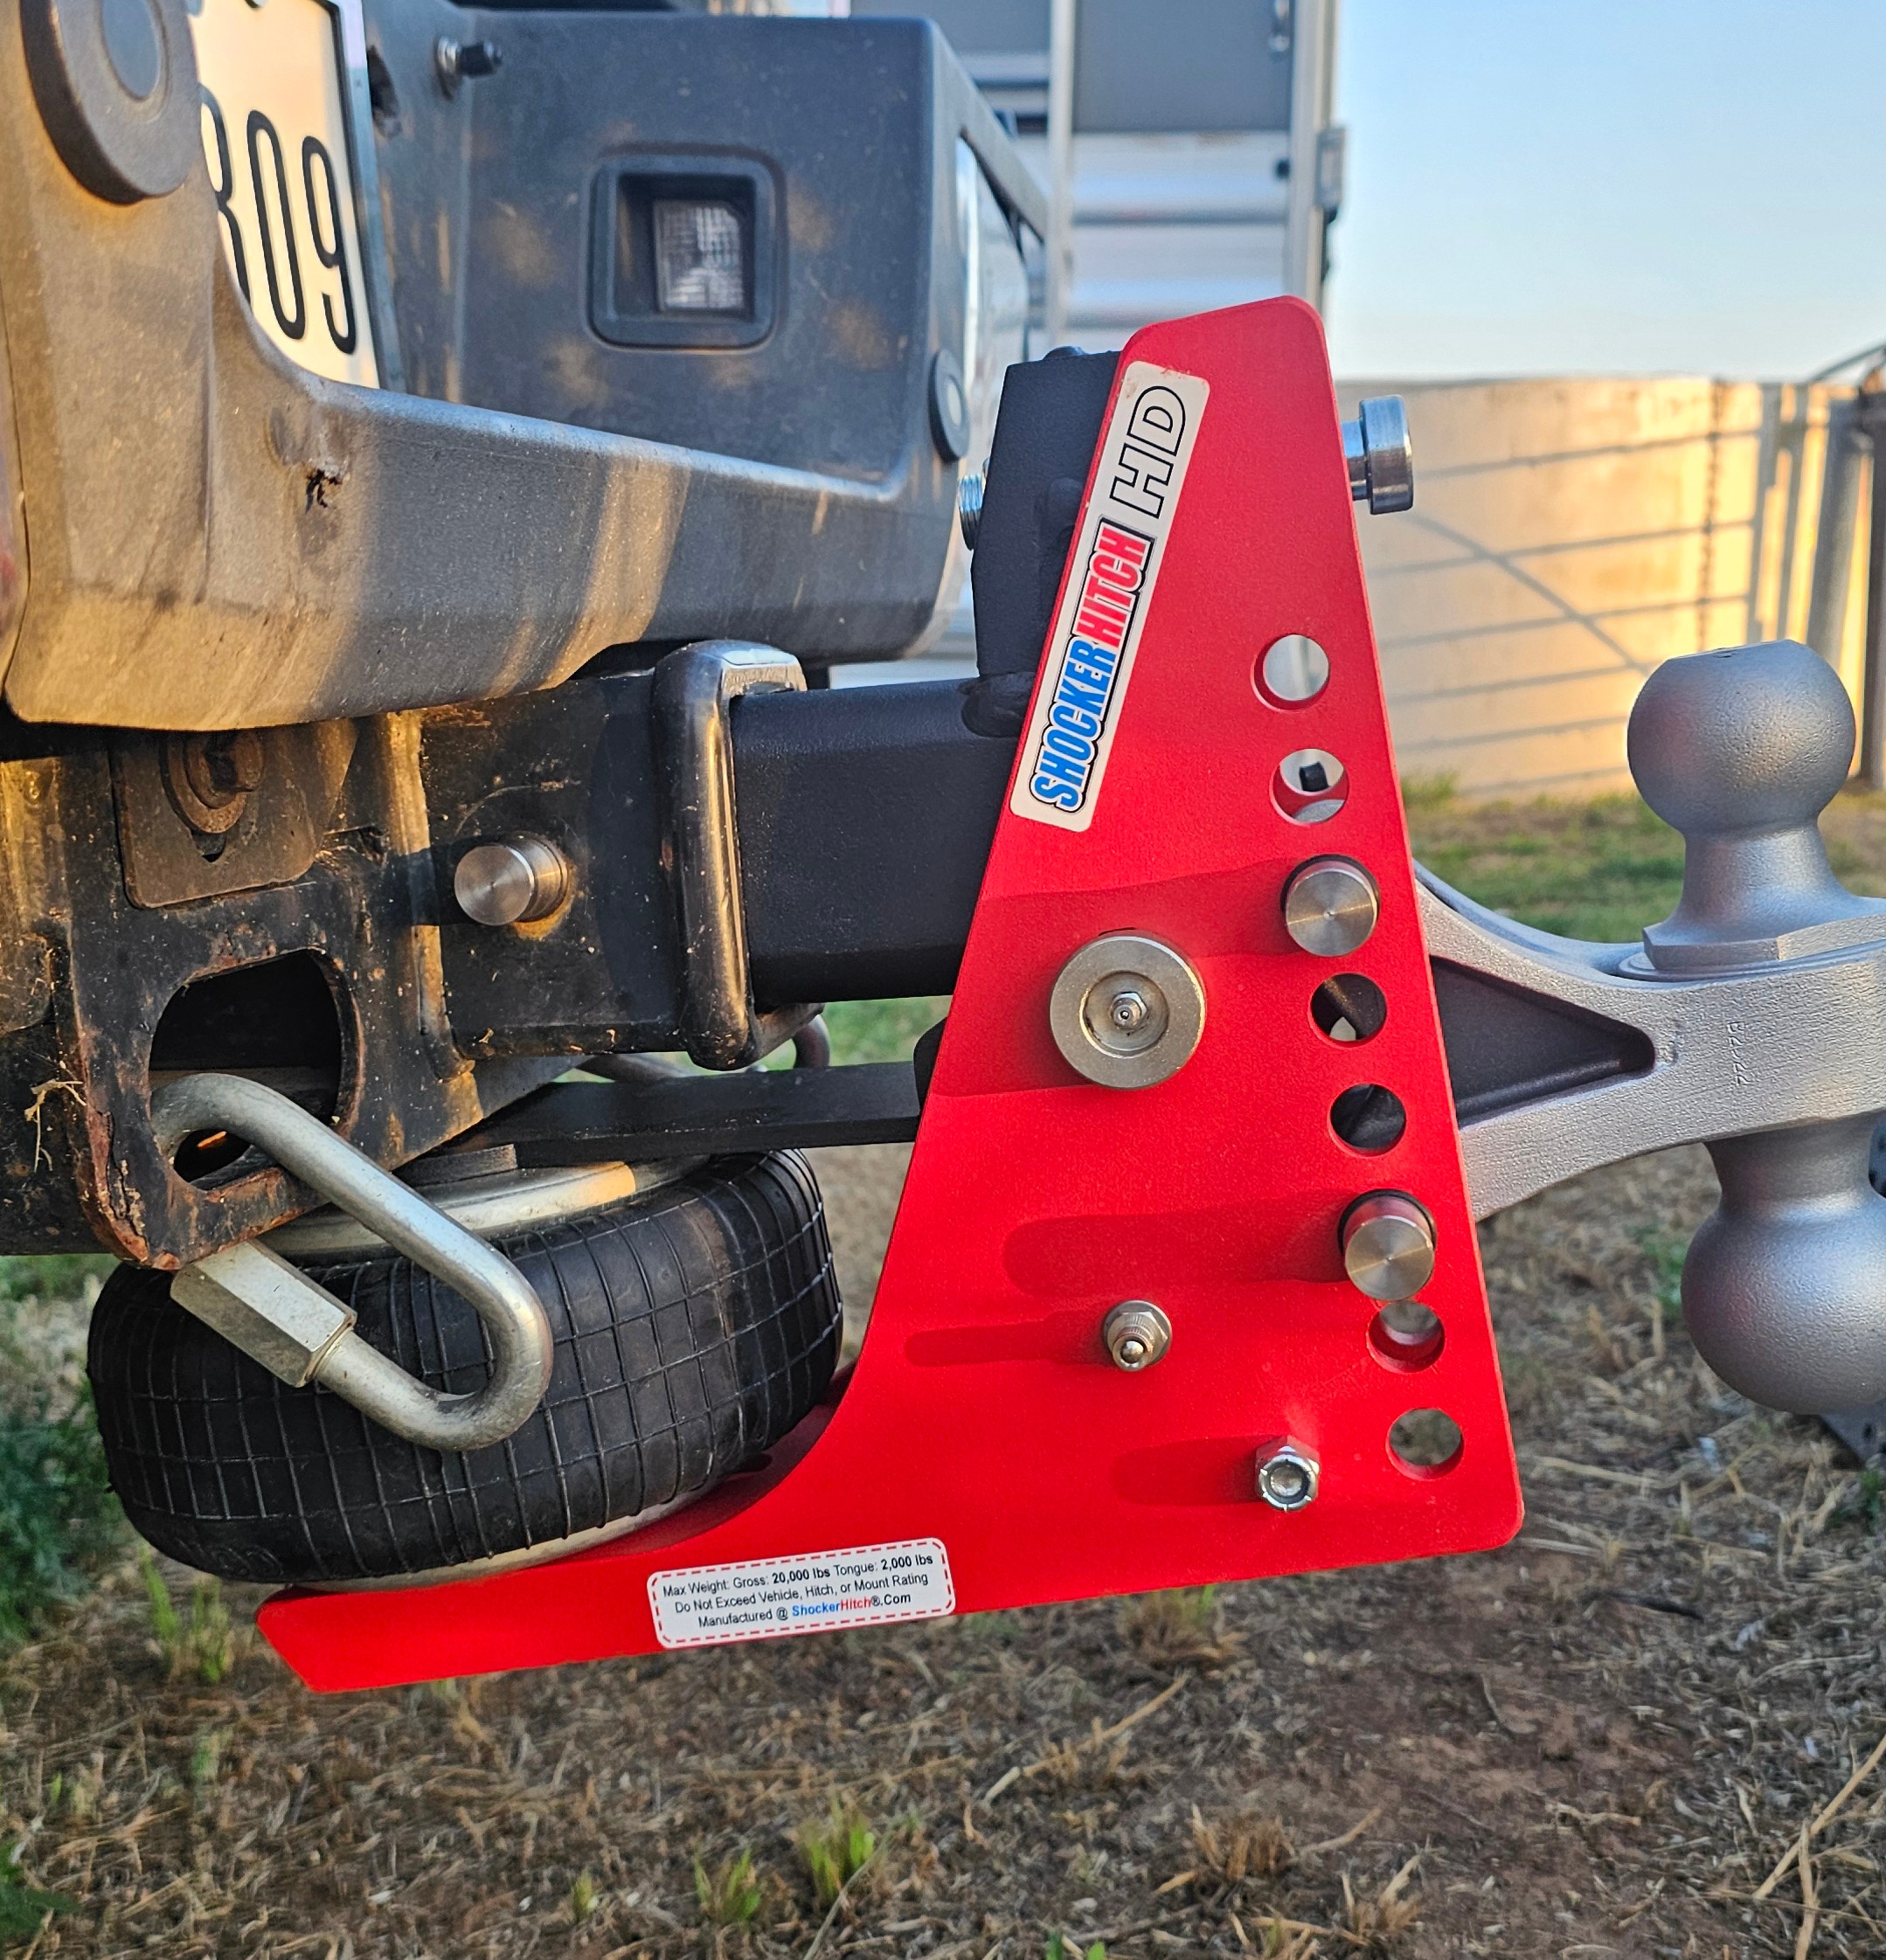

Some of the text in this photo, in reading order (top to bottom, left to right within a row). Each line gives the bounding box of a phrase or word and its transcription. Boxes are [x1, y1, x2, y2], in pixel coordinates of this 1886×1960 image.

[1109, 384, 1186, 518] HD
[662, 1555, 933, 1597] Max Weight: Gross: 20,000 lbs Tongue: 2,000 lbs
[676, 1575, 928, 1613] Do Not Exceed Vehicle, Hitch, or Mount Rating
[698, 1609, 773, 1628] Manufactured
